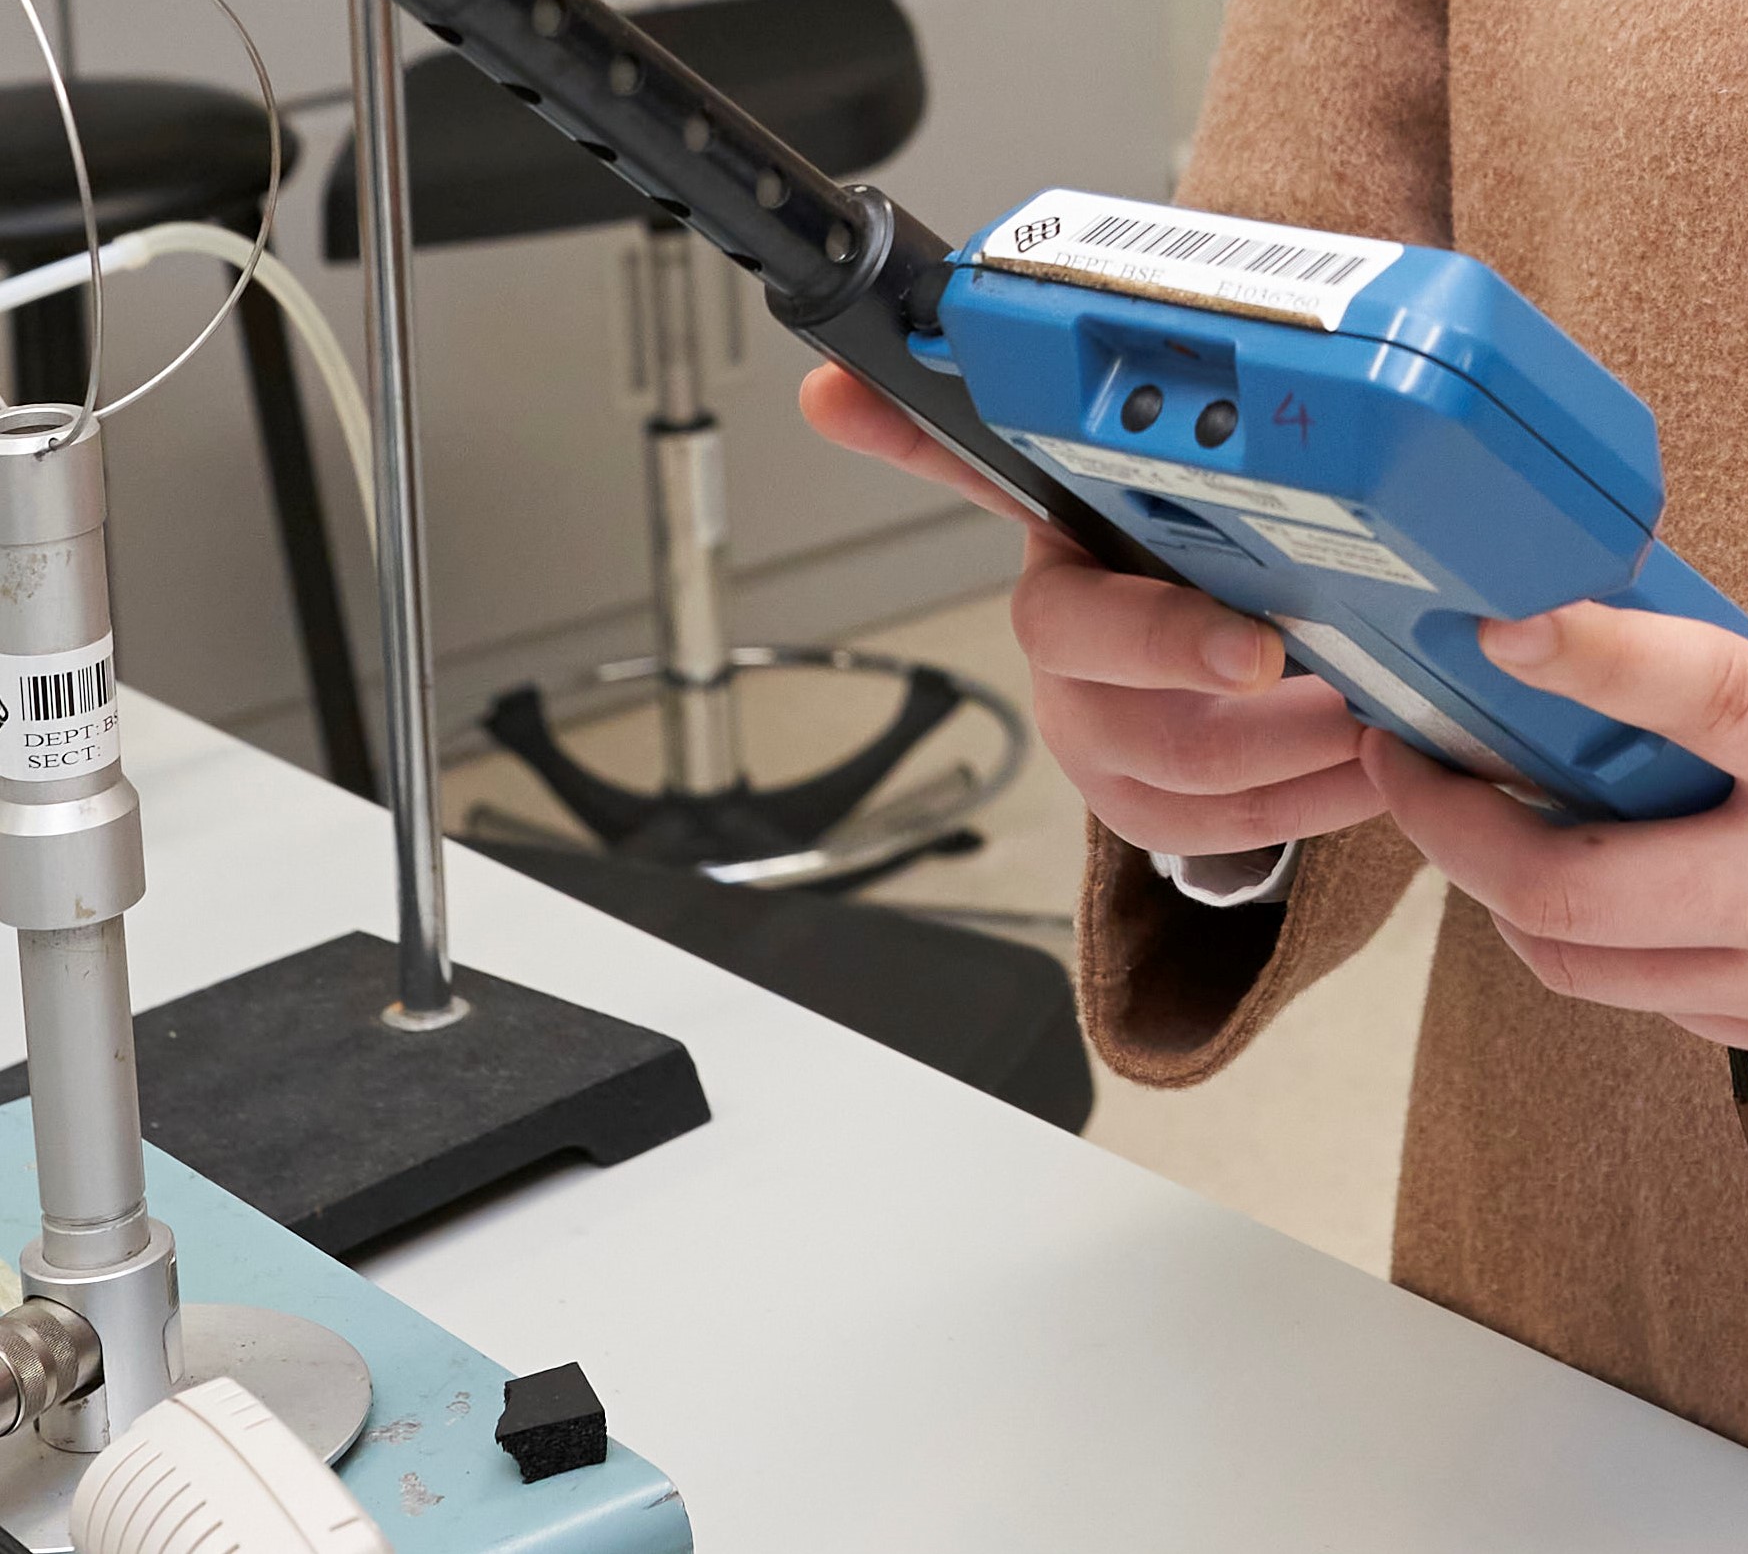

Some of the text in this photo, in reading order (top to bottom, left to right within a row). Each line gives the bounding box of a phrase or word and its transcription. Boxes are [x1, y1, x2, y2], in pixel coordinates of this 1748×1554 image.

[1120, 264, 1166, 284] BSE
[1272, 389, 1314, 444] 4
[24, 724, 99, 747] DEPT:
[28, 745, 101, 769] SECT:
